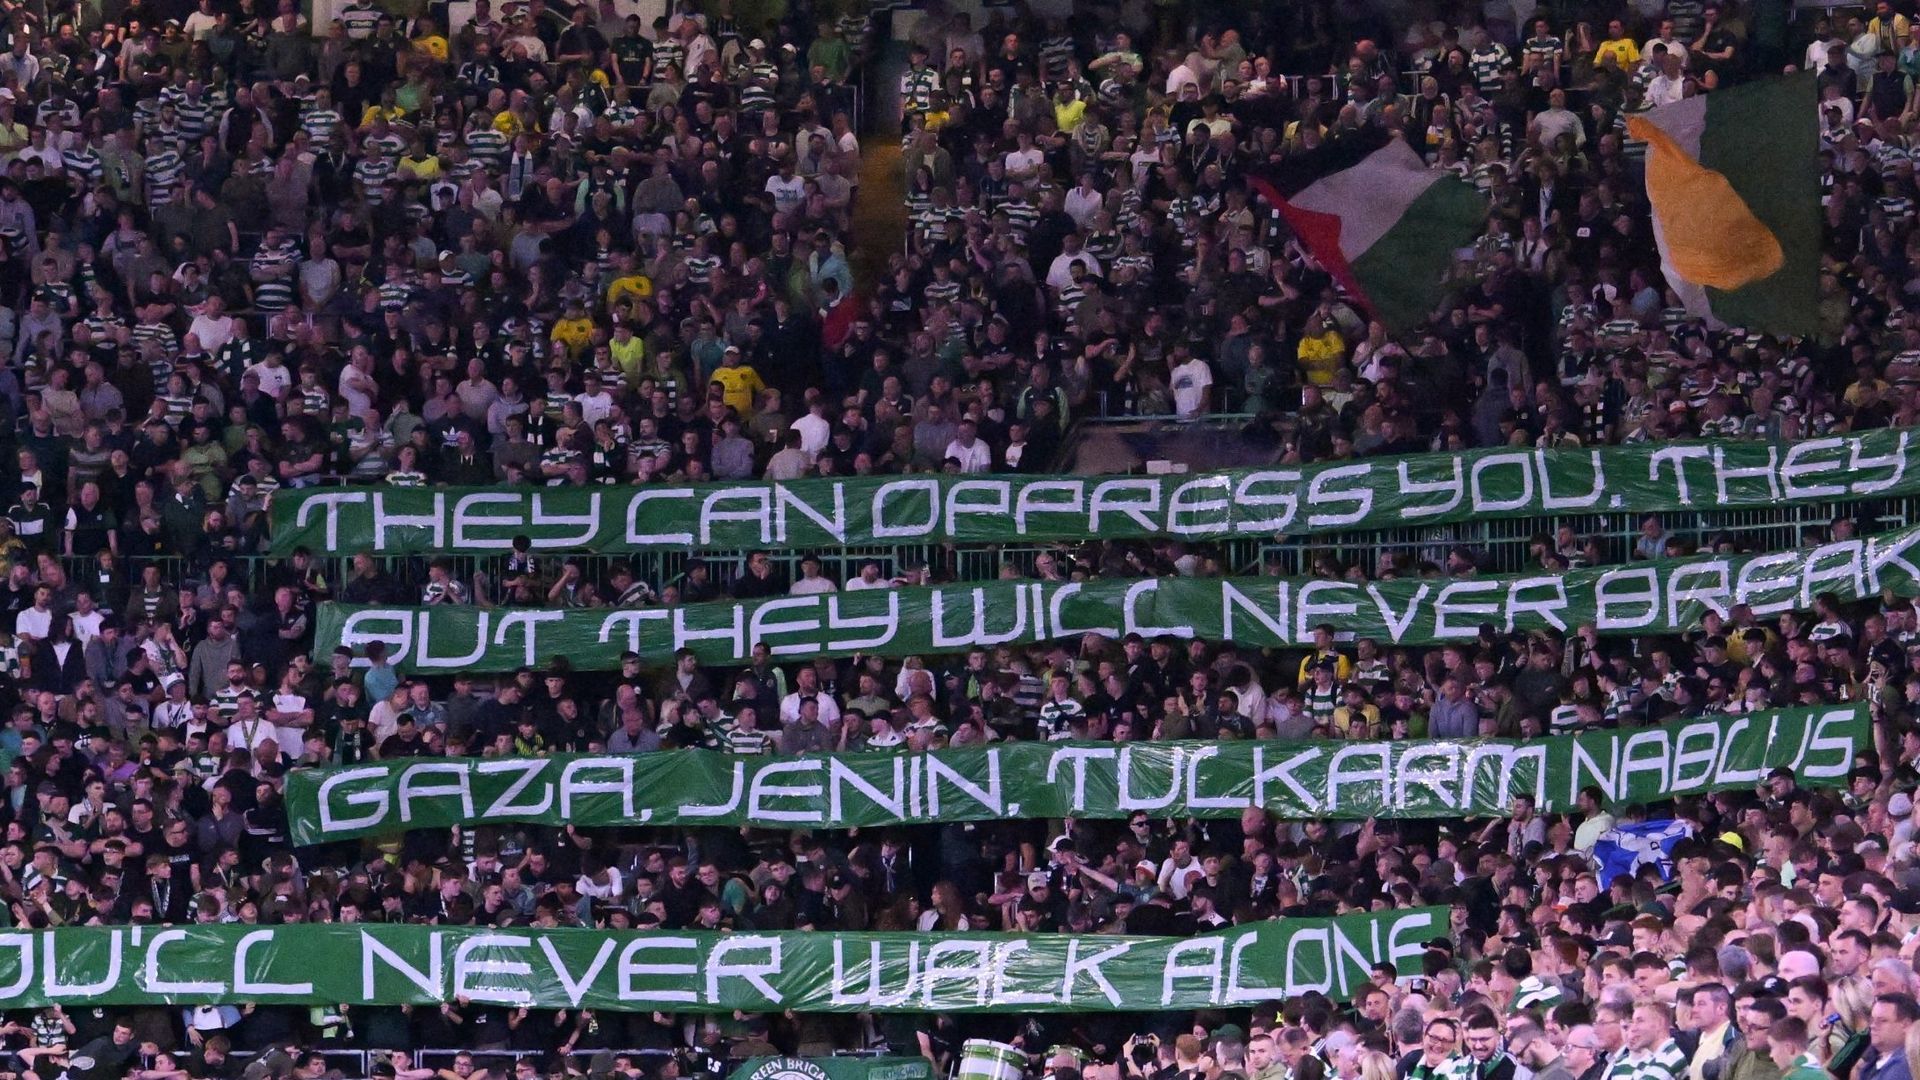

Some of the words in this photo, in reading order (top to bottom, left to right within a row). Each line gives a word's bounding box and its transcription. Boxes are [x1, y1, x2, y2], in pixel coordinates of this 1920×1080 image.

[297, 492, 600, 551] THEY
[626, 483, 844, 545] CAN
[873, 463, 1373, 537] OPPRESS
[1649, 431, 1908, 505] THEY
[341, 609, 565, 668] BUT
[599, 591, 898, 658] THEY
[932, 578, 1193, 648] WILL
[1222, 576, 1568, 643] NEVER
[1596, 527, 1920, 630] BREAK
[1570, 709, 1855, 804] NABLUS
[361, 929, 784, 1007] NEVER
[831, 938, 1130, 1007] WALK
[1162, 913, 1432, 1006] ALONE
